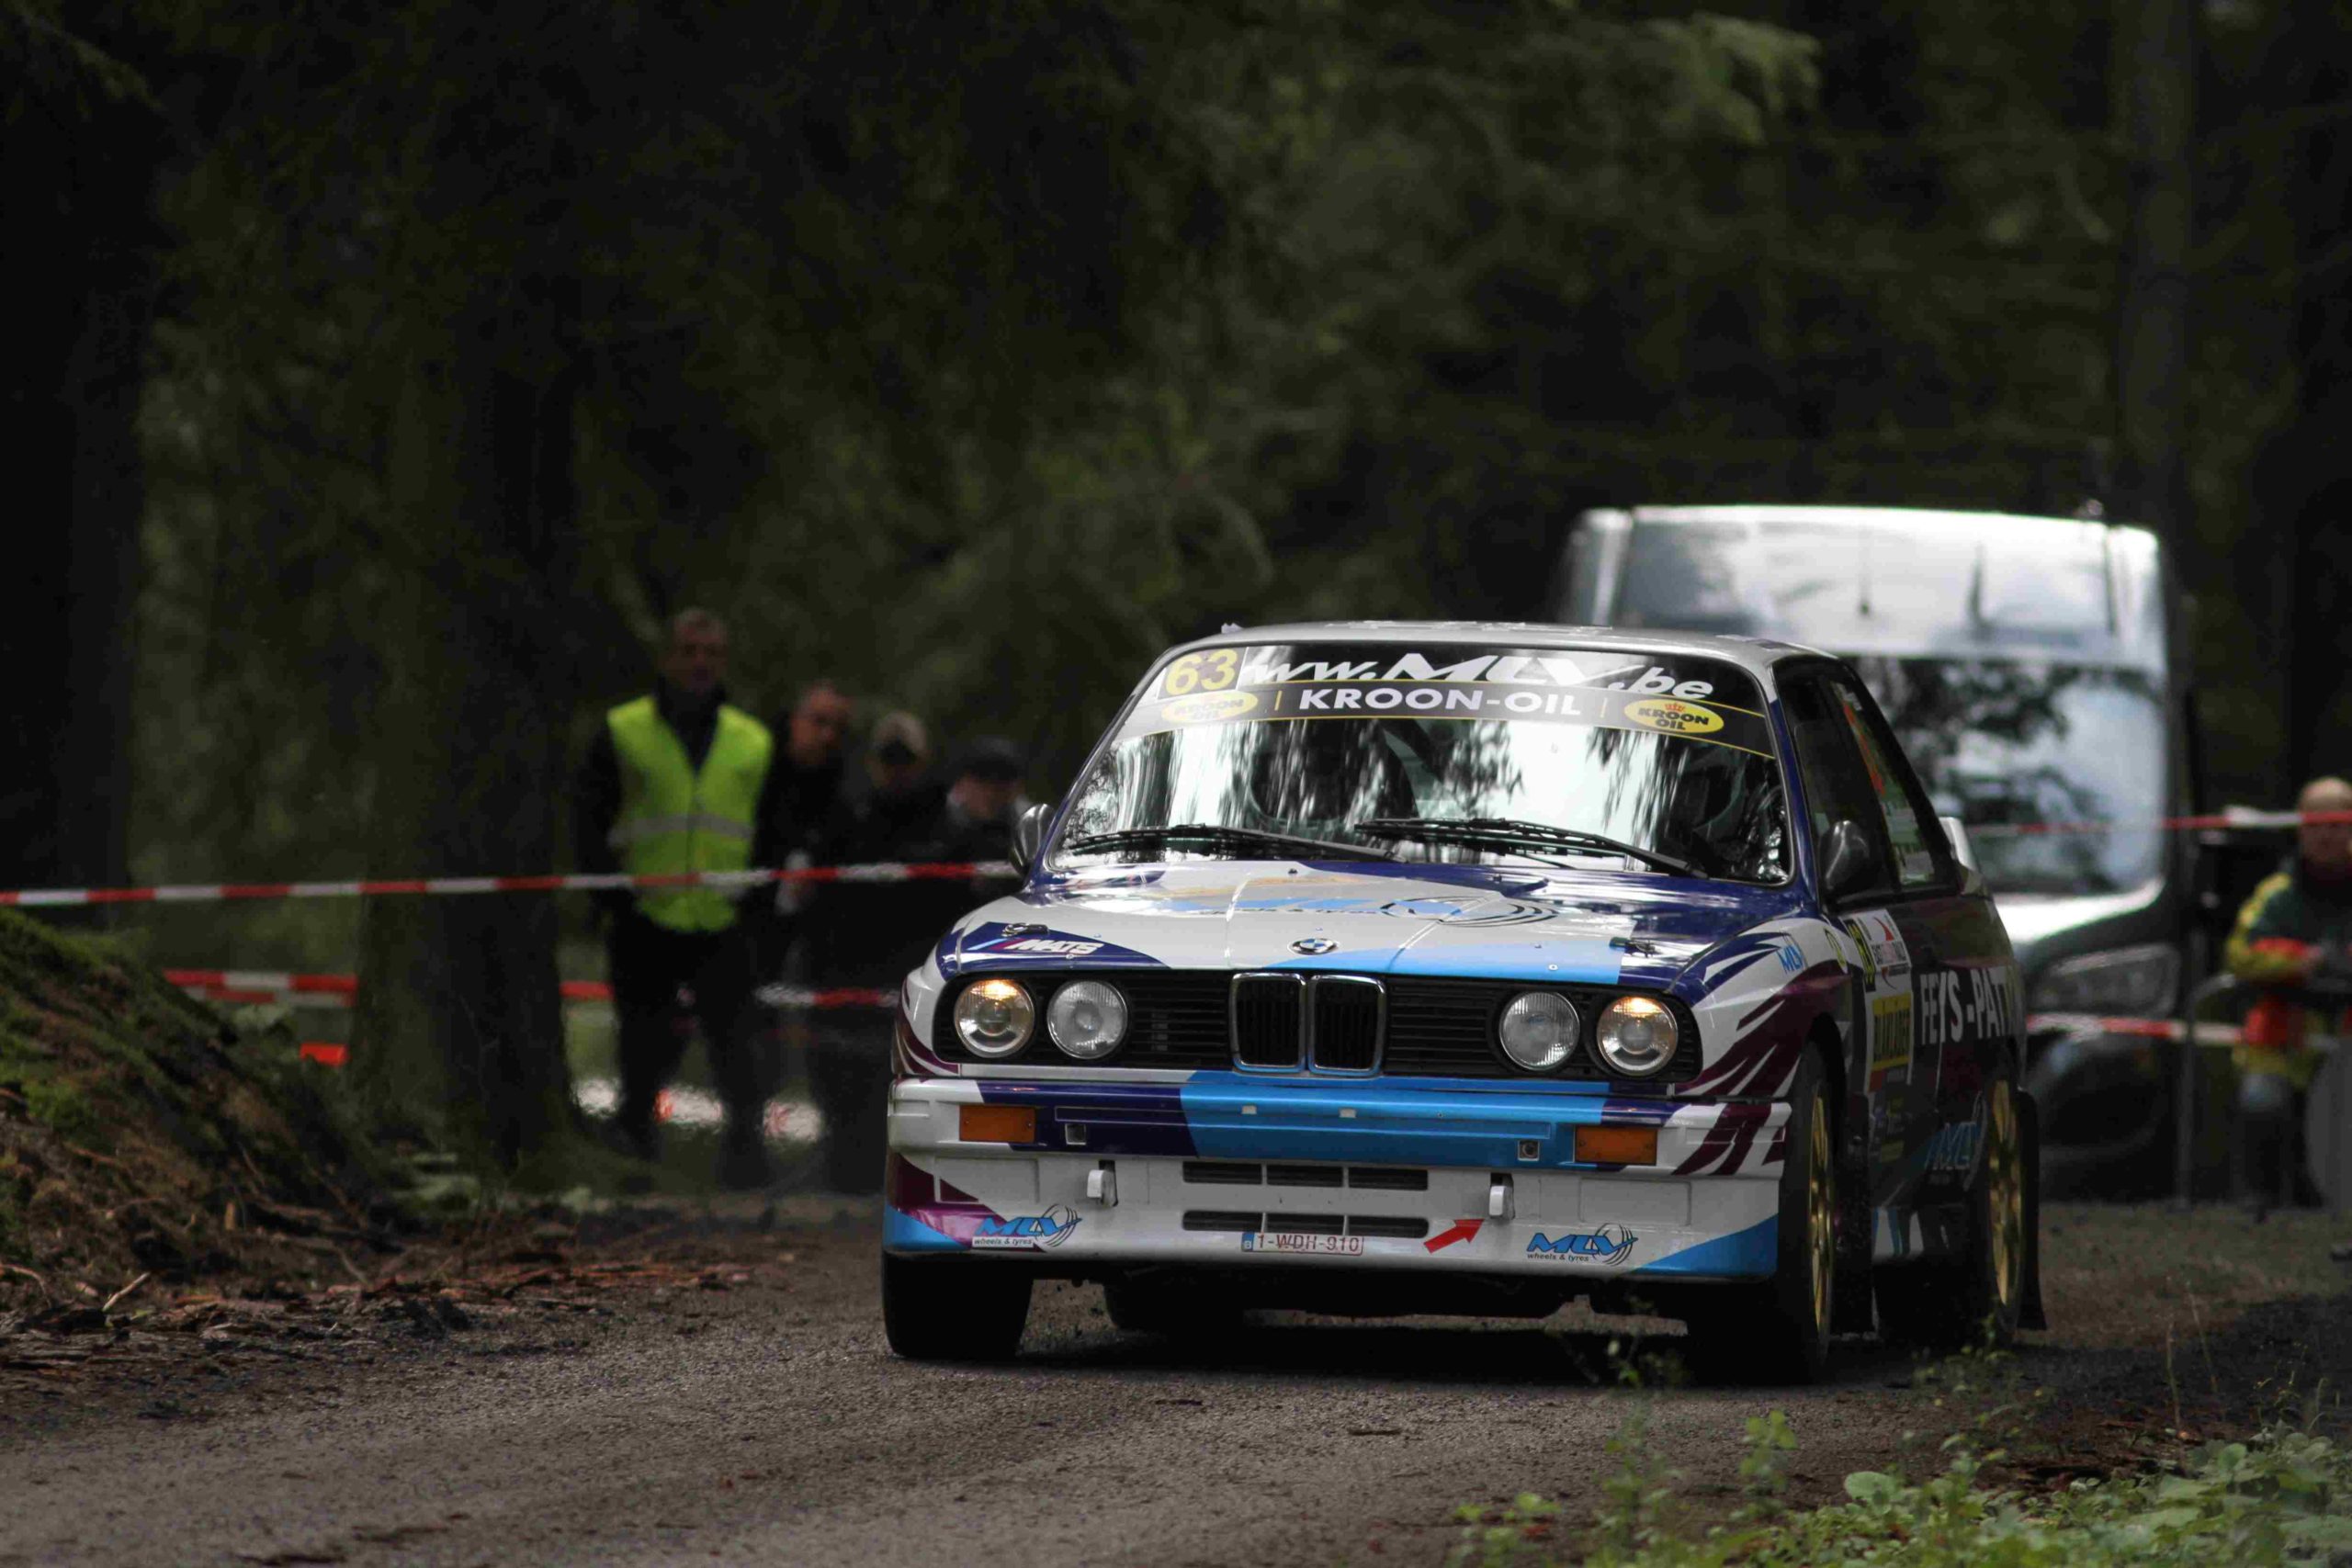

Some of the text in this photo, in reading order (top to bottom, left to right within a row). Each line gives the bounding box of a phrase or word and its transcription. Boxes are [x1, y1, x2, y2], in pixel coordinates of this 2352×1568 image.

[1166, 649, 1238, 695] 63
[1298, 686, 1581, 716] KROON-OIL
[1637, 705, 1710, 726] KROON
[1656, 718, 1687, 731] OIL
[974, 1237, 1001, 1246] wheels
[1012, 1238, 1033, 1247] tyres
[1257, 1234, 1360, 1252] 1-WDH-910
[1527, 1253, 1557, 1261] wheels
[1567, 1255, 1590, 1263] tyres
